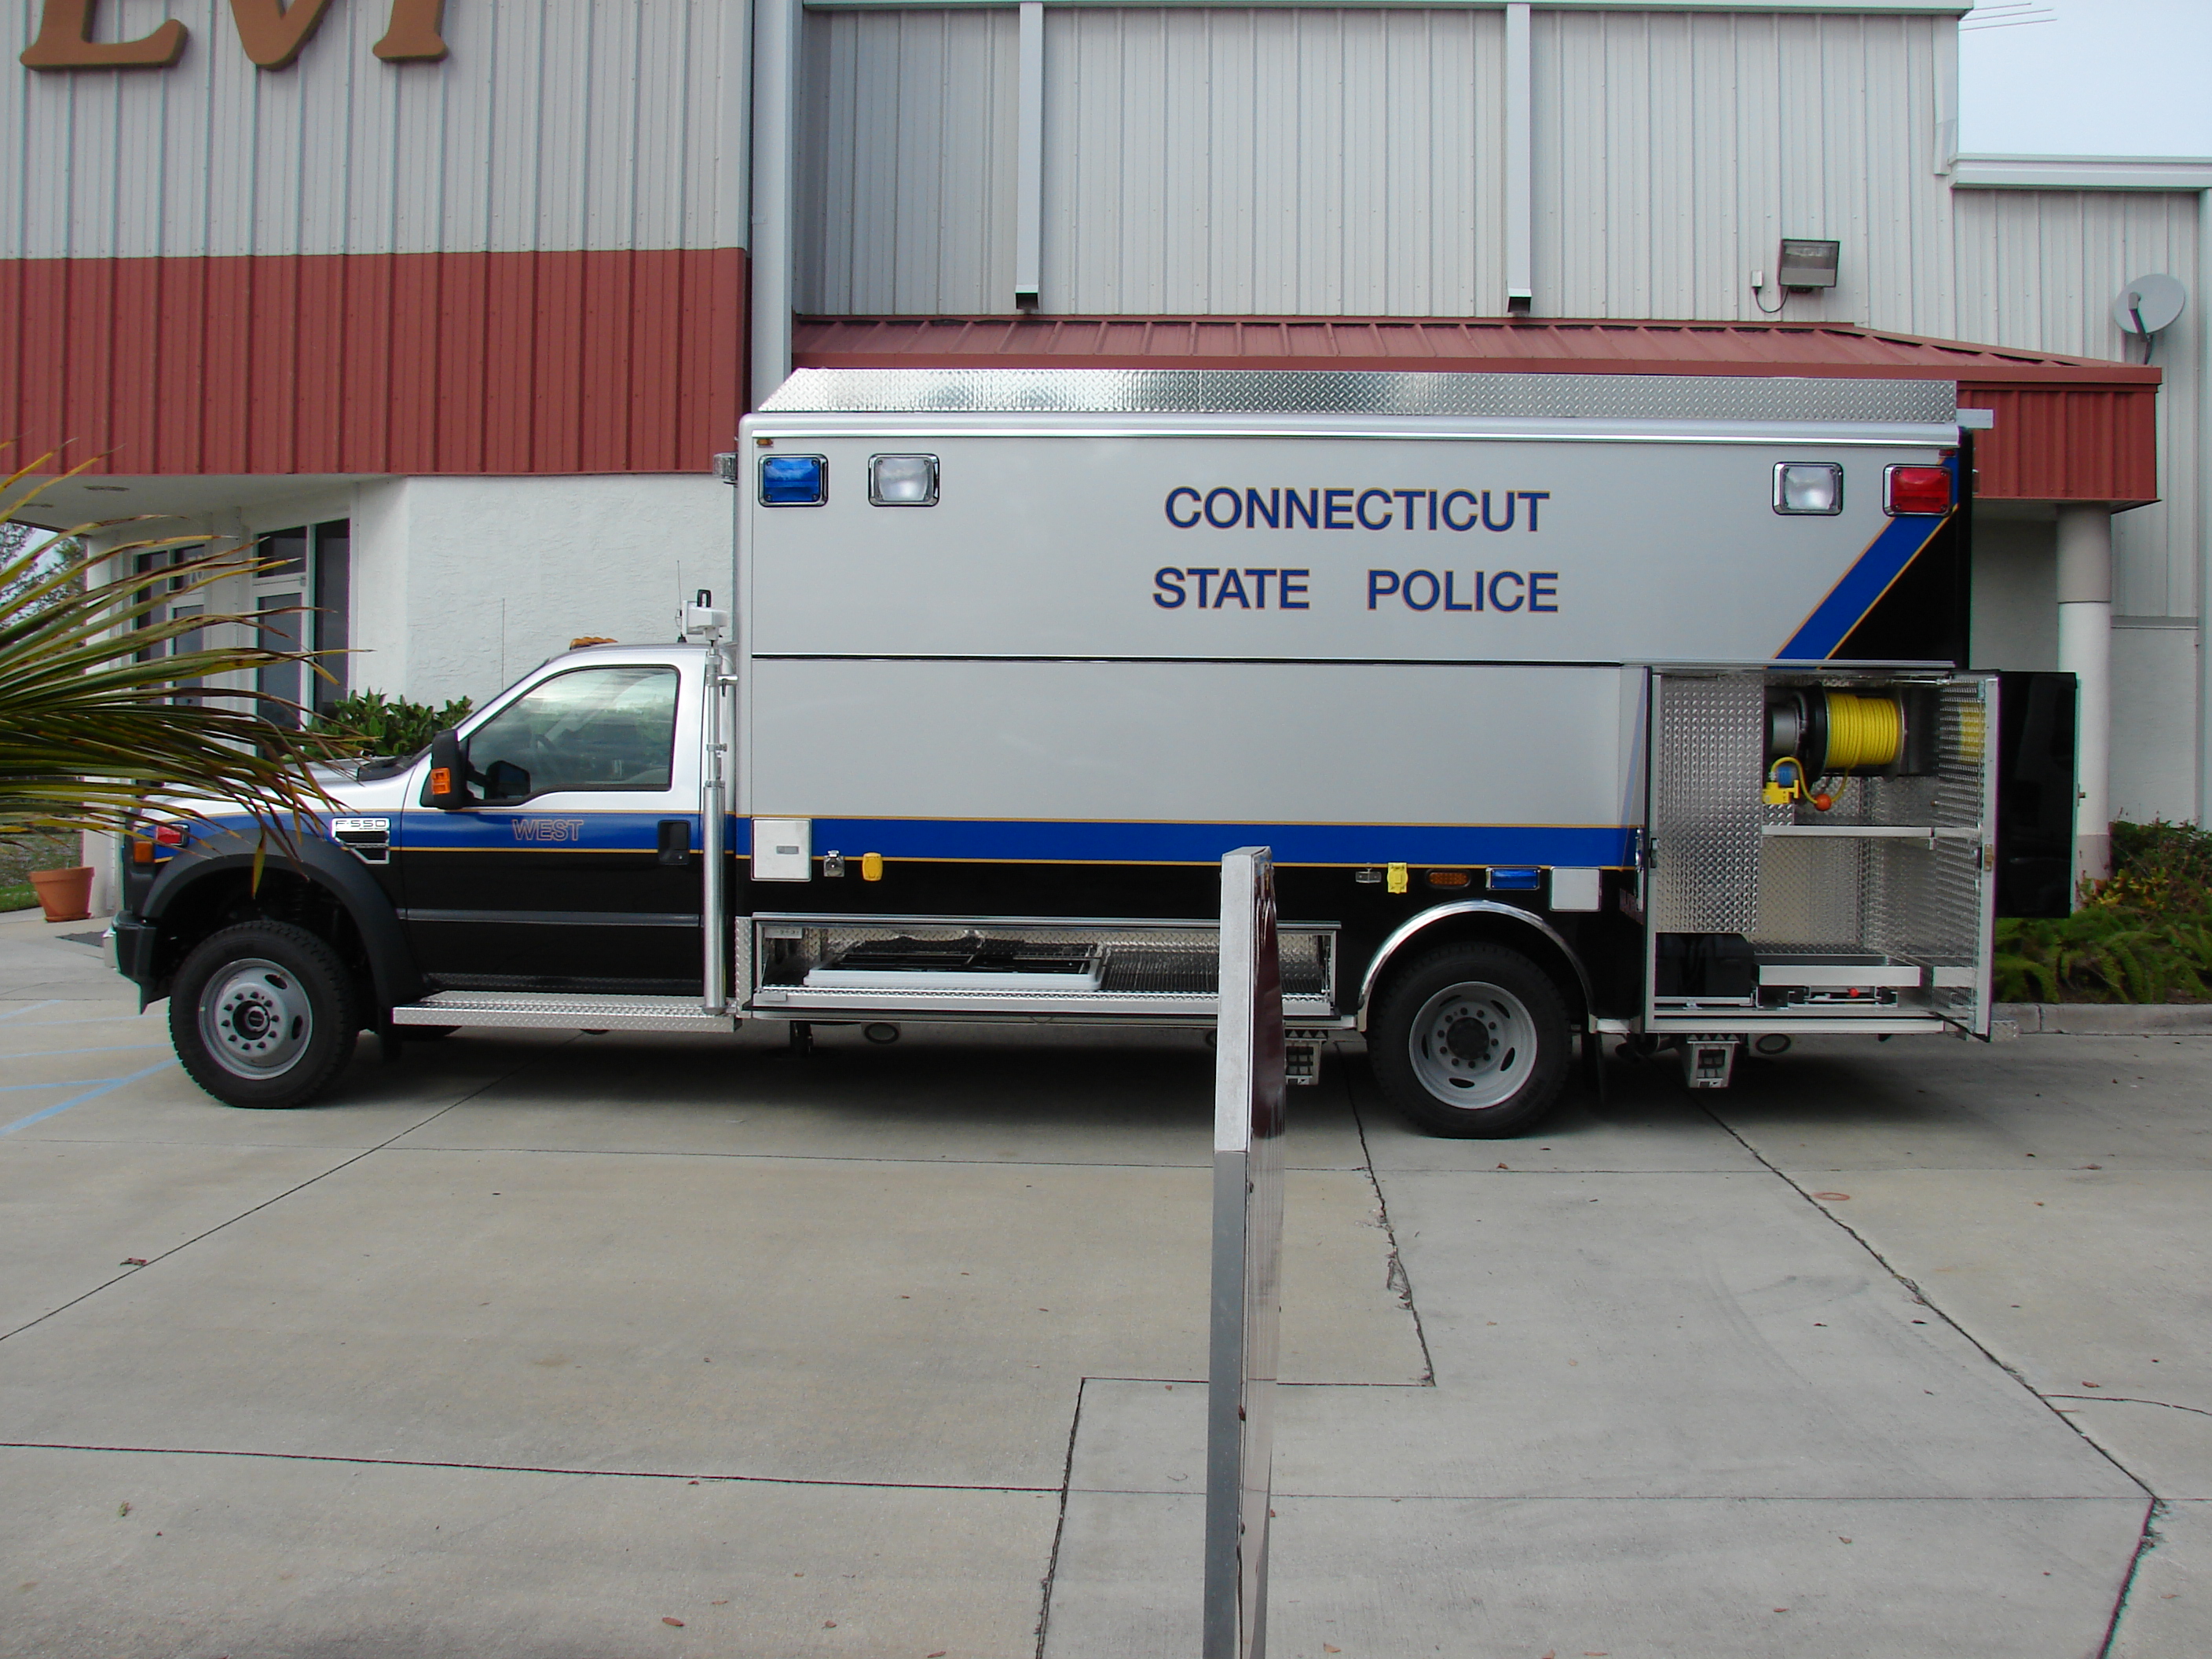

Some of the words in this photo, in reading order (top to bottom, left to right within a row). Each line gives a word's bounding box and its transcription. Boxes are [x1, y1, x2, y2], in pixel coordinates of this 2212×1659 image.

[1164, 485, 1551, 533] CONNECTICUT
[1152, 566, 1311, 610] STATE
[1366, 568, 1560, 614] POLICE
[511, 819, 584, 842] WEST
